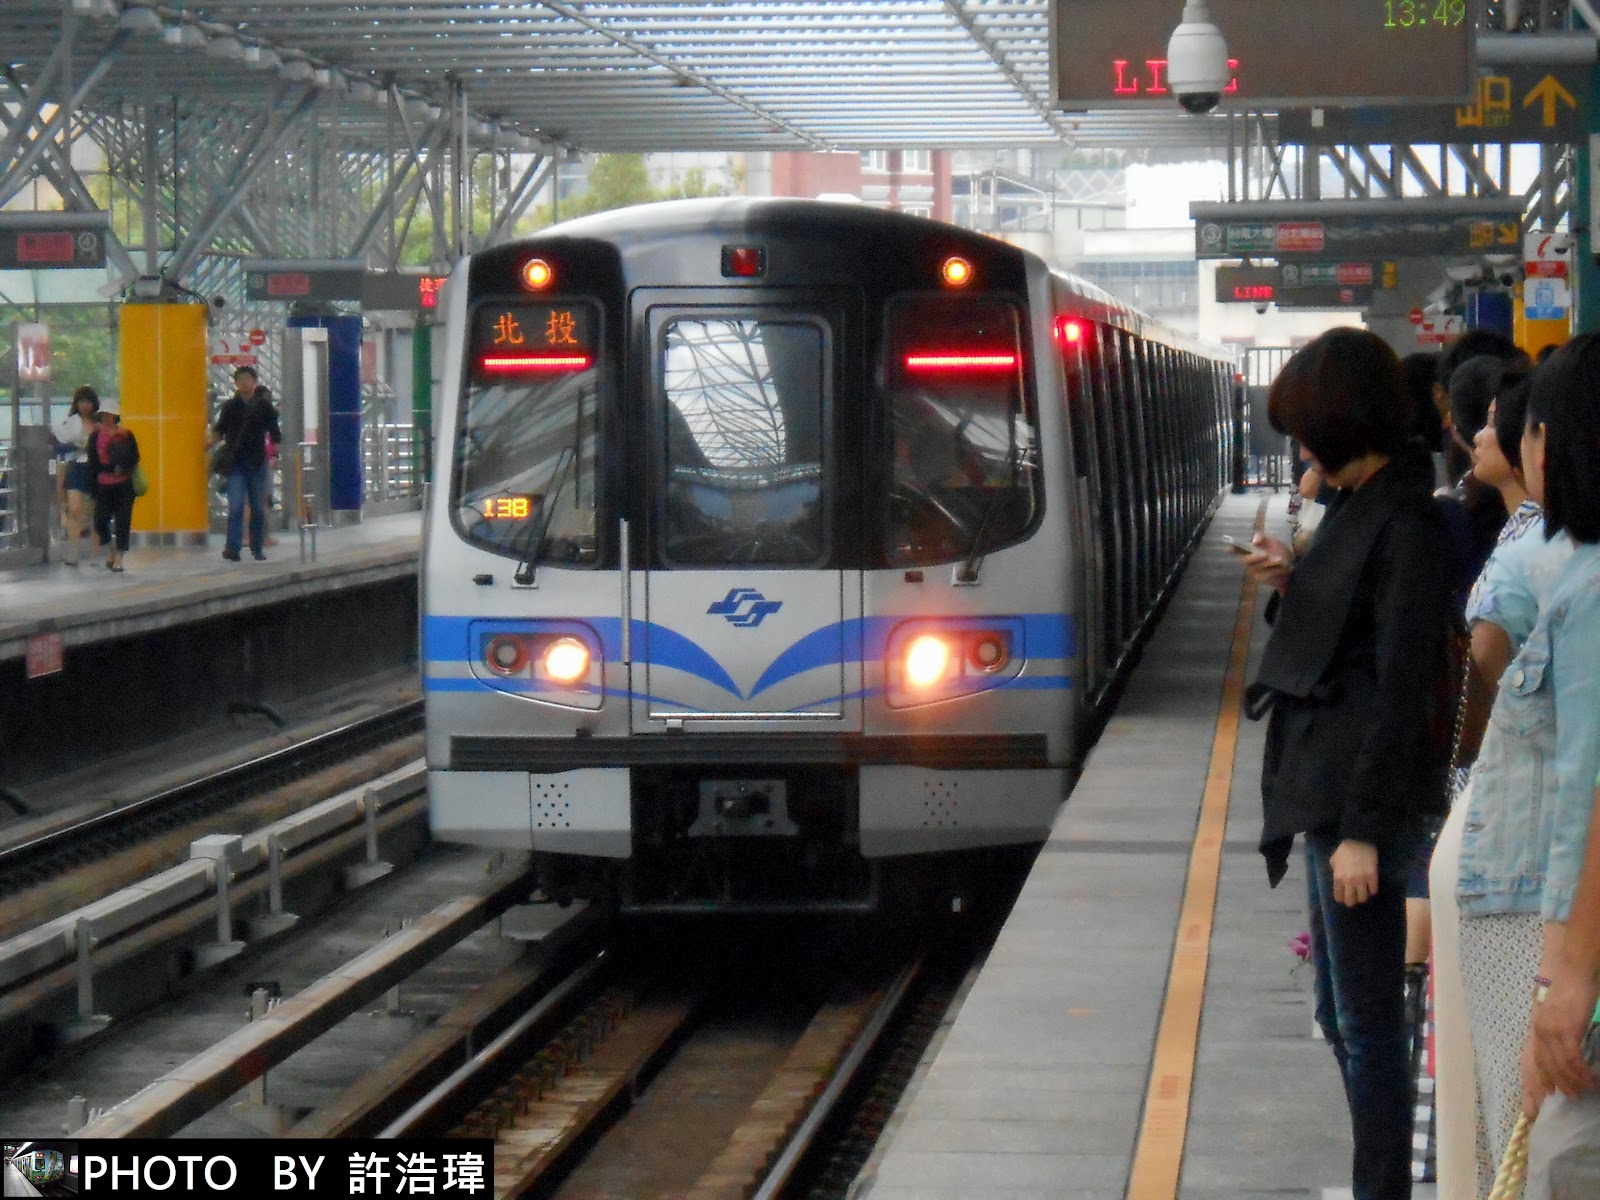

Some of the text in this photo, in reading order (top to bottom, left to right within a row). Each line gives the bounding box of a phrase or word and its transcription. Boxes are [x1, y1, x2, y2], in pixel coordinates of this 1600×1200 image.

[1384, 0, 1466, 26] 13:49
[1113, 59, 1238, 93] LI
[492, 310, 578, 344] 北投
[483, 498, 528, 518] 138
